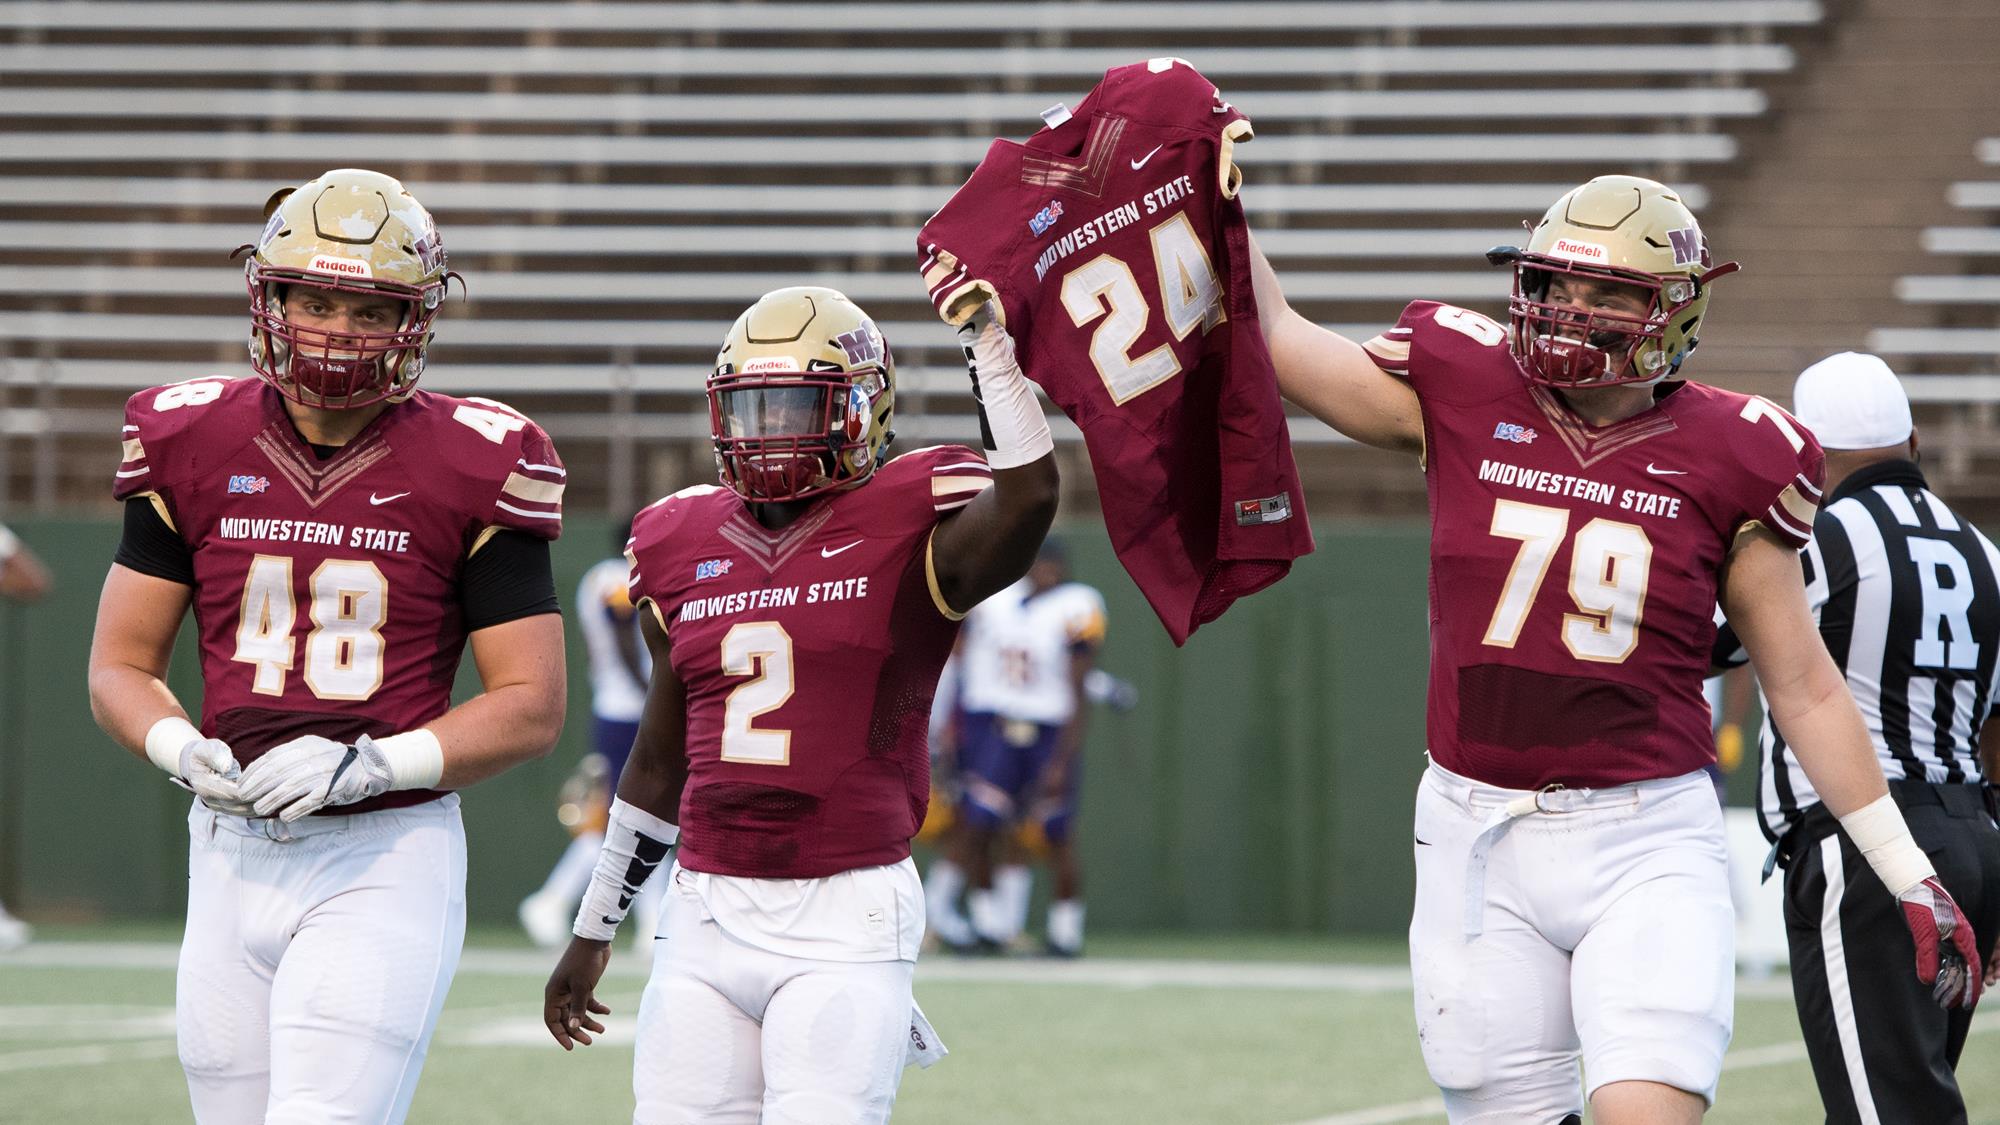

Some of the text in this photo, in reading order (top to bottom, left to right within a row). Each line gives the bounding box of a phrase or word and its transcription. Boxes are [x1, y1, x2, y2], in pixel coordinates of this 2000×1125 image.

[315, 259, 365, 275] Riddell
[1034, 174, 1195, 283] MIDWESTERN STATE
[1060, 211, 1227, 408] 24
[152, 375, 235, 412] 8
[452, 397, 533, 445] 4
[1478, 459, 1682, 519] MIDWESTERN STATE
[220, 517, 411, 554] MIDWESTERN STATE
[679, 576, 869, 623] MIDWESTERN STATE
[1481, 498, 1654, 664] 79
[1907, 536, 1980, 670] R
[231, 553, 390, 702] 48
[720, 621, 795, 767] 2
